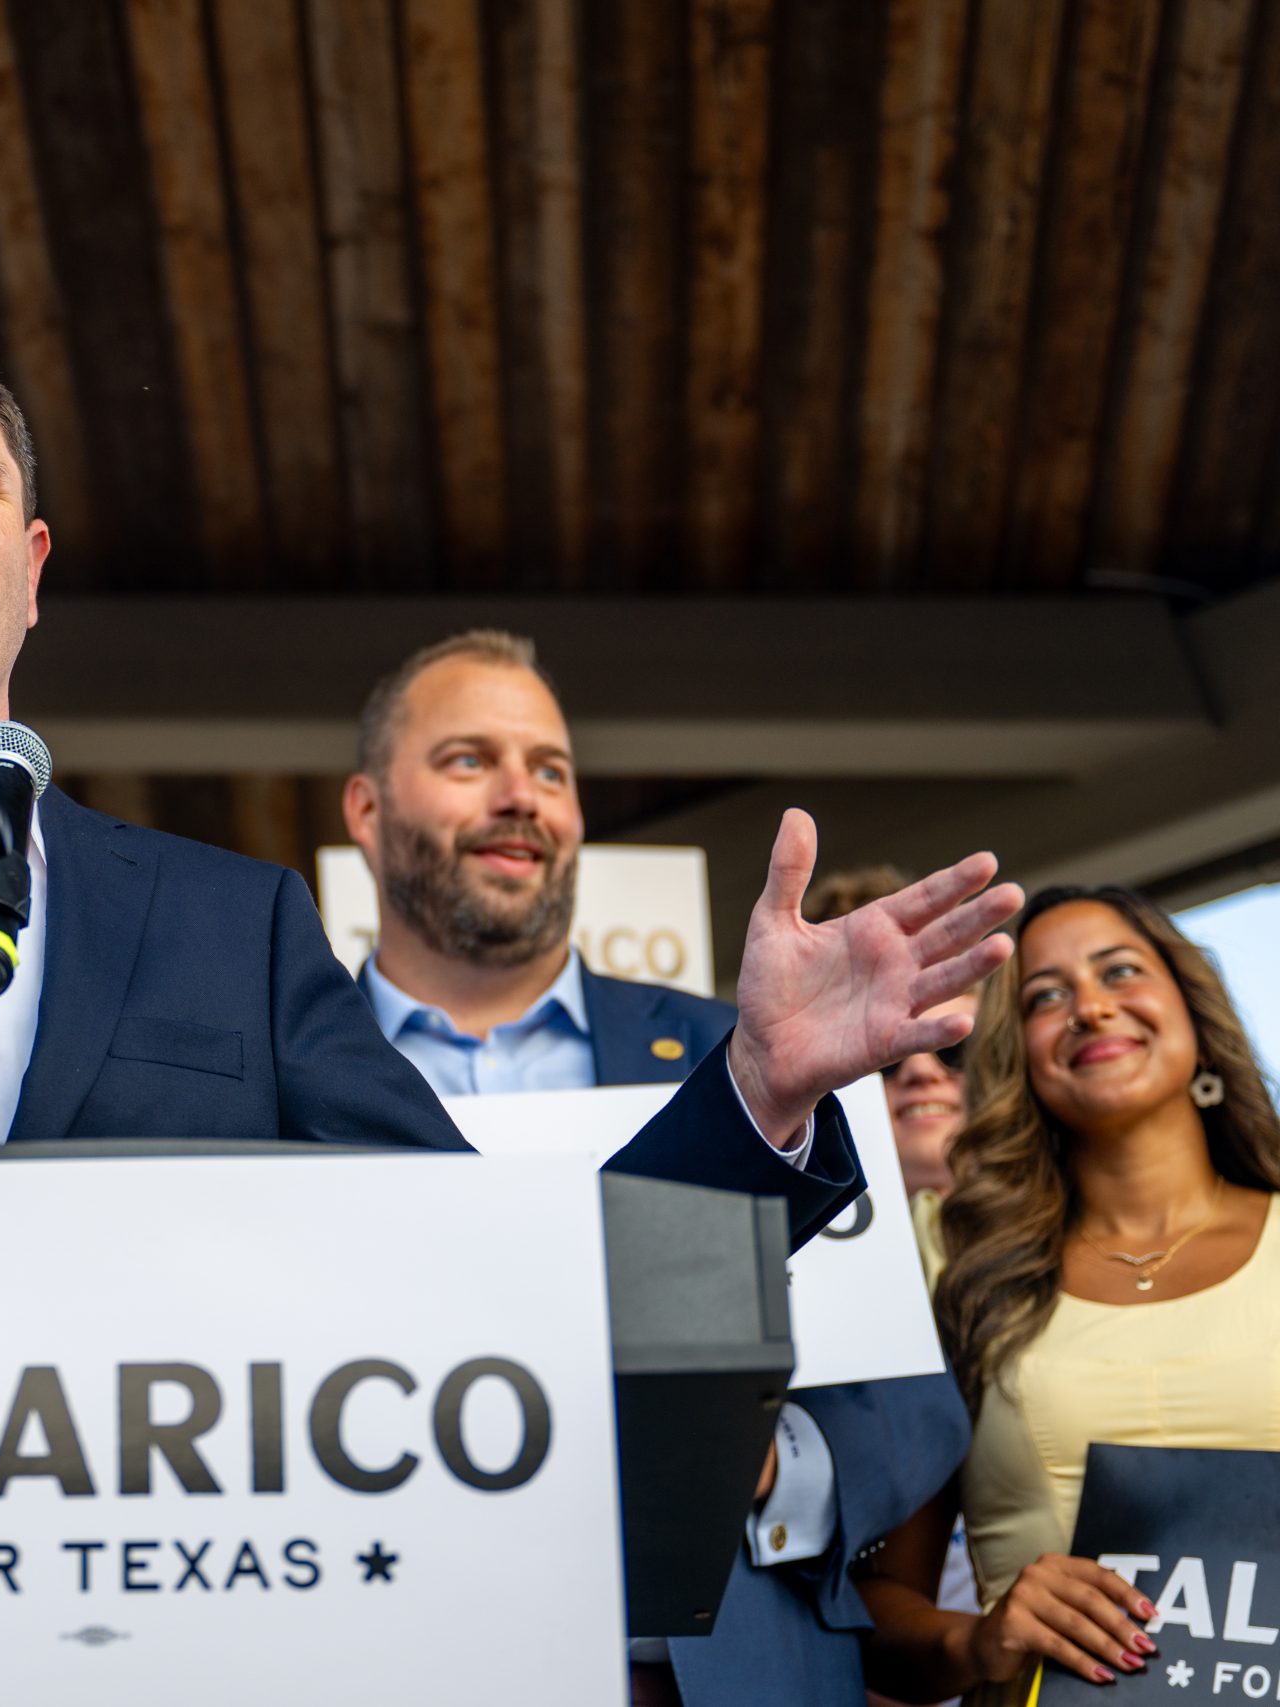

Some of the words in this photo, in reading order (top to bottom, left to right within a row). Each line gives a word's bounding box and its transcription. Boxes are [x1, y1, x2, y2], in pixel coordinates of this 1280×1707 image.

[61, 1539, 321, 1592] TEXAS
[1097, 1553, 1279, 1645] TAL
[1212, 1661, 1280, 1702] FO
